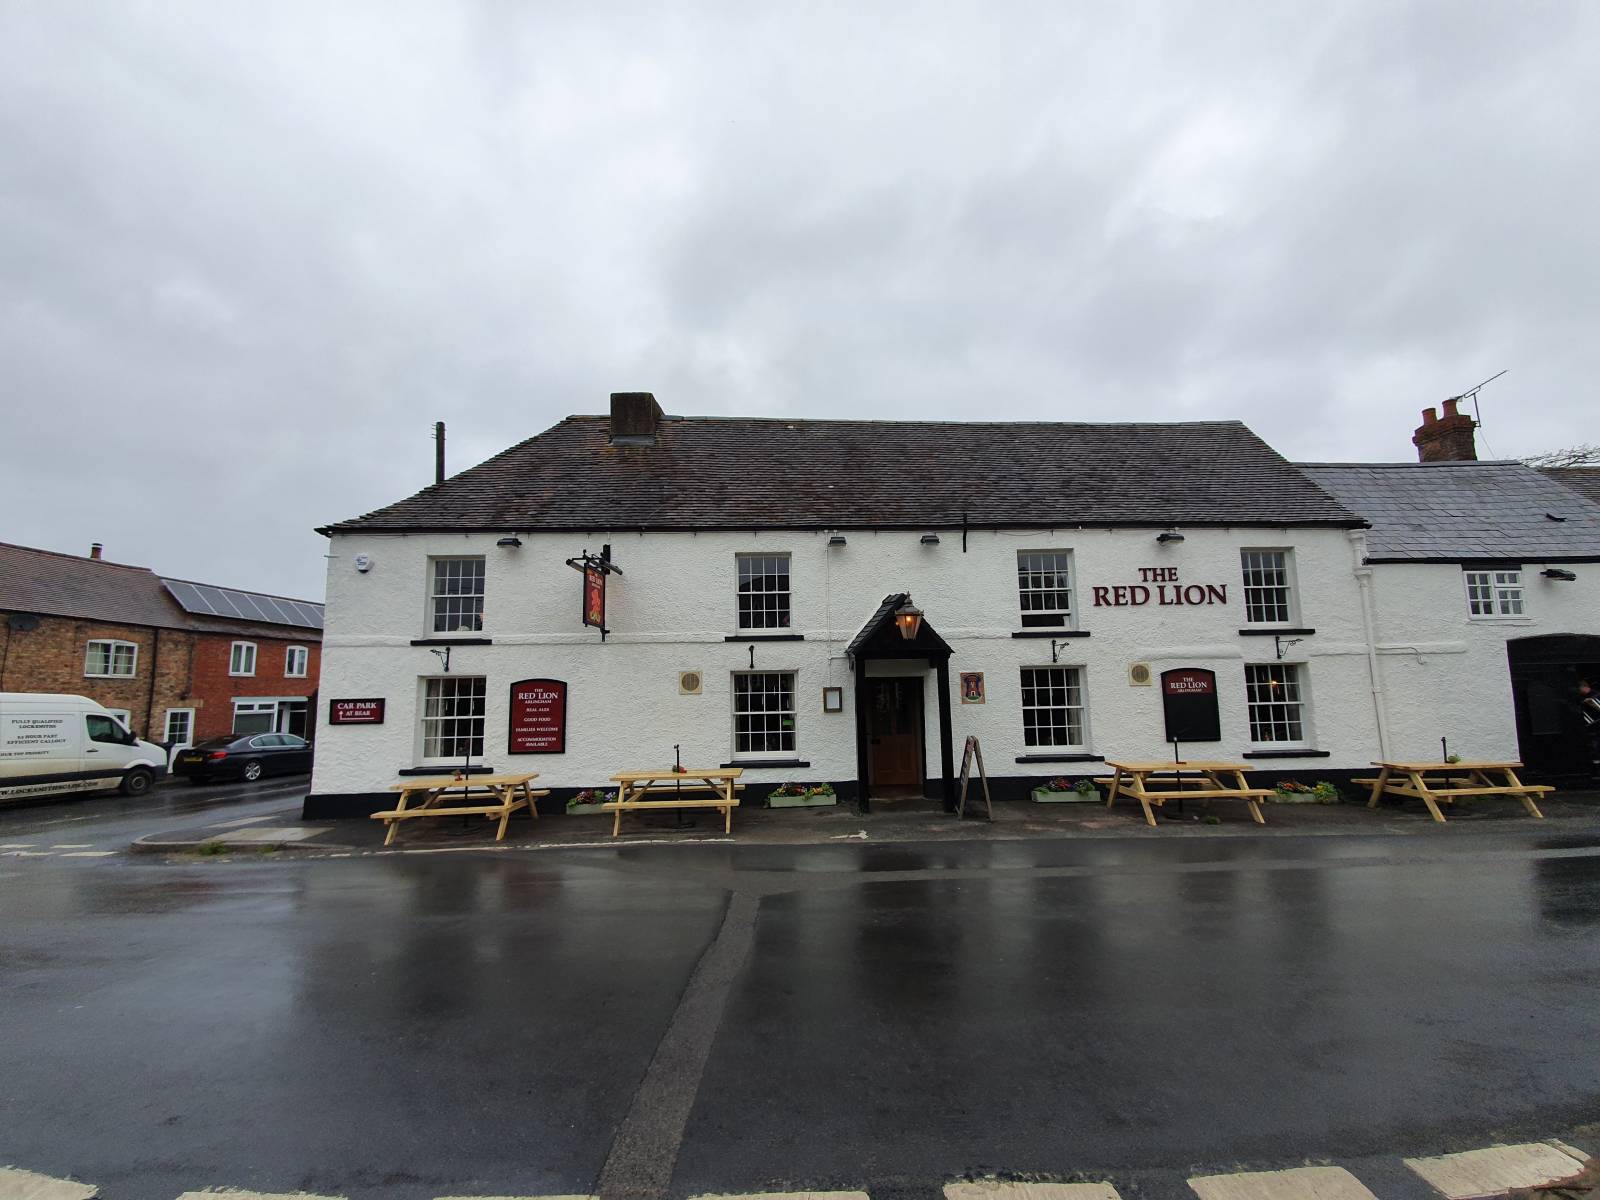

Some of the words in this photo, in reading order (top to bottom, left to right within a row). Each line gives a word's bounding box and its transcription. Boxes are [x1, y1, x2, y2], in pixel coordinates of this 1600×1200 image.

[1138, 568, 1178, 582] THE
[1092, 586, 1150, 607] RED
[1156, 584, 1228, 606] LION
